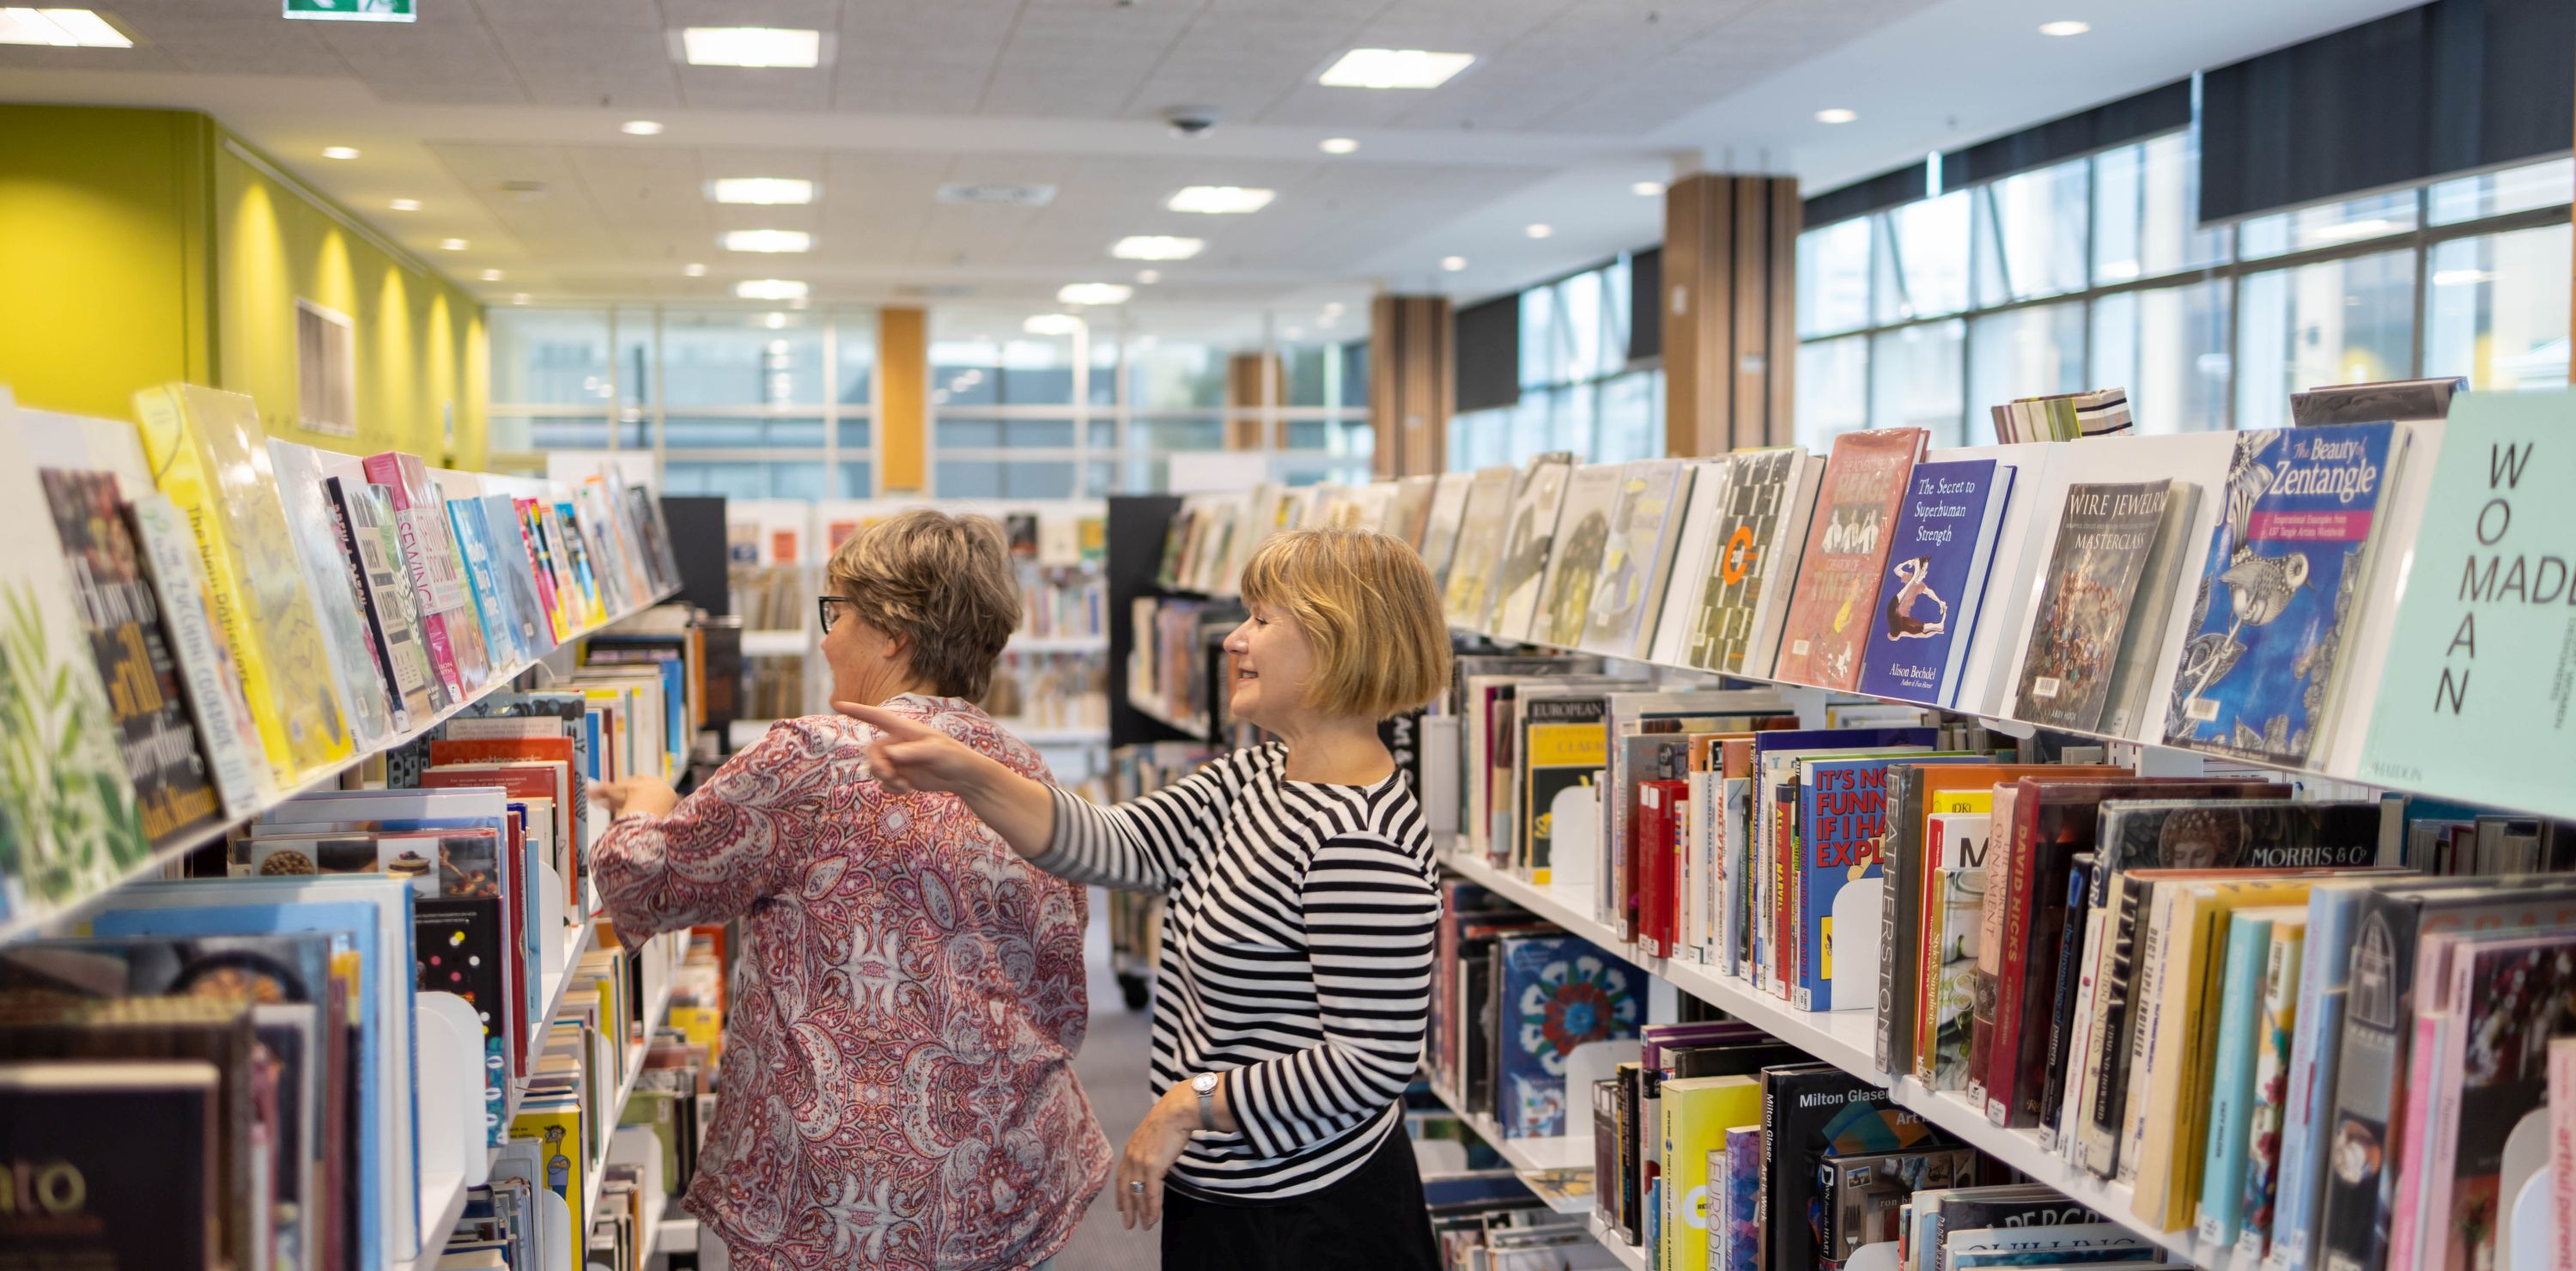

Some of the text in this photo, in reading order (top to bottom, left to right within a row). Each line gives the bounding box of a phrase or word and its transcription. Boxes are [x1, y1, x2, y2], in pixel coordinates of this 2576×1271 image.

[2294, 440, 2310, 459] The
[2311, 438, 2359, 464] Beauty
[1918, 477, 1976, 495] The Secret to
[2269, 458, 2378, 503] Zentangle
[1914, 500, 1966, 522] Superhuman
[2069, 490, 2171, 523] WIRE JEWELRY
[1917, 524, 1952, 547] Strength
[2075, 532, 2146, 550] MASTERCLASS
[1889, 662, 1937, 680] Alison Bechdel
[1534, 702, 1602, 716] EUROPEAN
[1816, 769, 1856, 791] IT'S
[1816, 790, 1887, 817] FUNN
[1953, 802, 1971, 813] DK
[1816, 817, 1838, 842] IF
[1843, 816, 1850, 839] I
[1816, 840, 1886, 868] EXPL
[2251, 846, 2334, 867] MORRIS
[2336, 846, 2346, 863] &
[1985, 823, 2004, 938] ORNAMENT
[2008, 824, 2029, 963] DAVID HICKS
[1932, 932, 1941, 960] Style
[2109, 892, 2137, 1007] ITALIA
[1932, 961, 1939, 970] &
[1927, 970, 1939, 1026] Simplicity
[2093, 953, 2115, 1056] Period Styles
[2134, 927, 2158, 1058] DUCT TAPE ENGINEER
[2049, 1025, 2062, 1066] pattern
[2067, 1067, 2079, 1098] design
[2095, 1023, 2116, 1121] EDMUND HOWARD
[1800, 1089, 1889, 1108] Milton Glaser
[1896, 1113, 1920, 1125] Art
[2557, 1128, 2573, 1191] artful
[1760, 1183, 1767, 1194] is
[1708, 1161, 1722, 1271] EURODE
[1880, 1198, 1898, 1208] ron
[2555, 1195, 2573, 1269] parent
